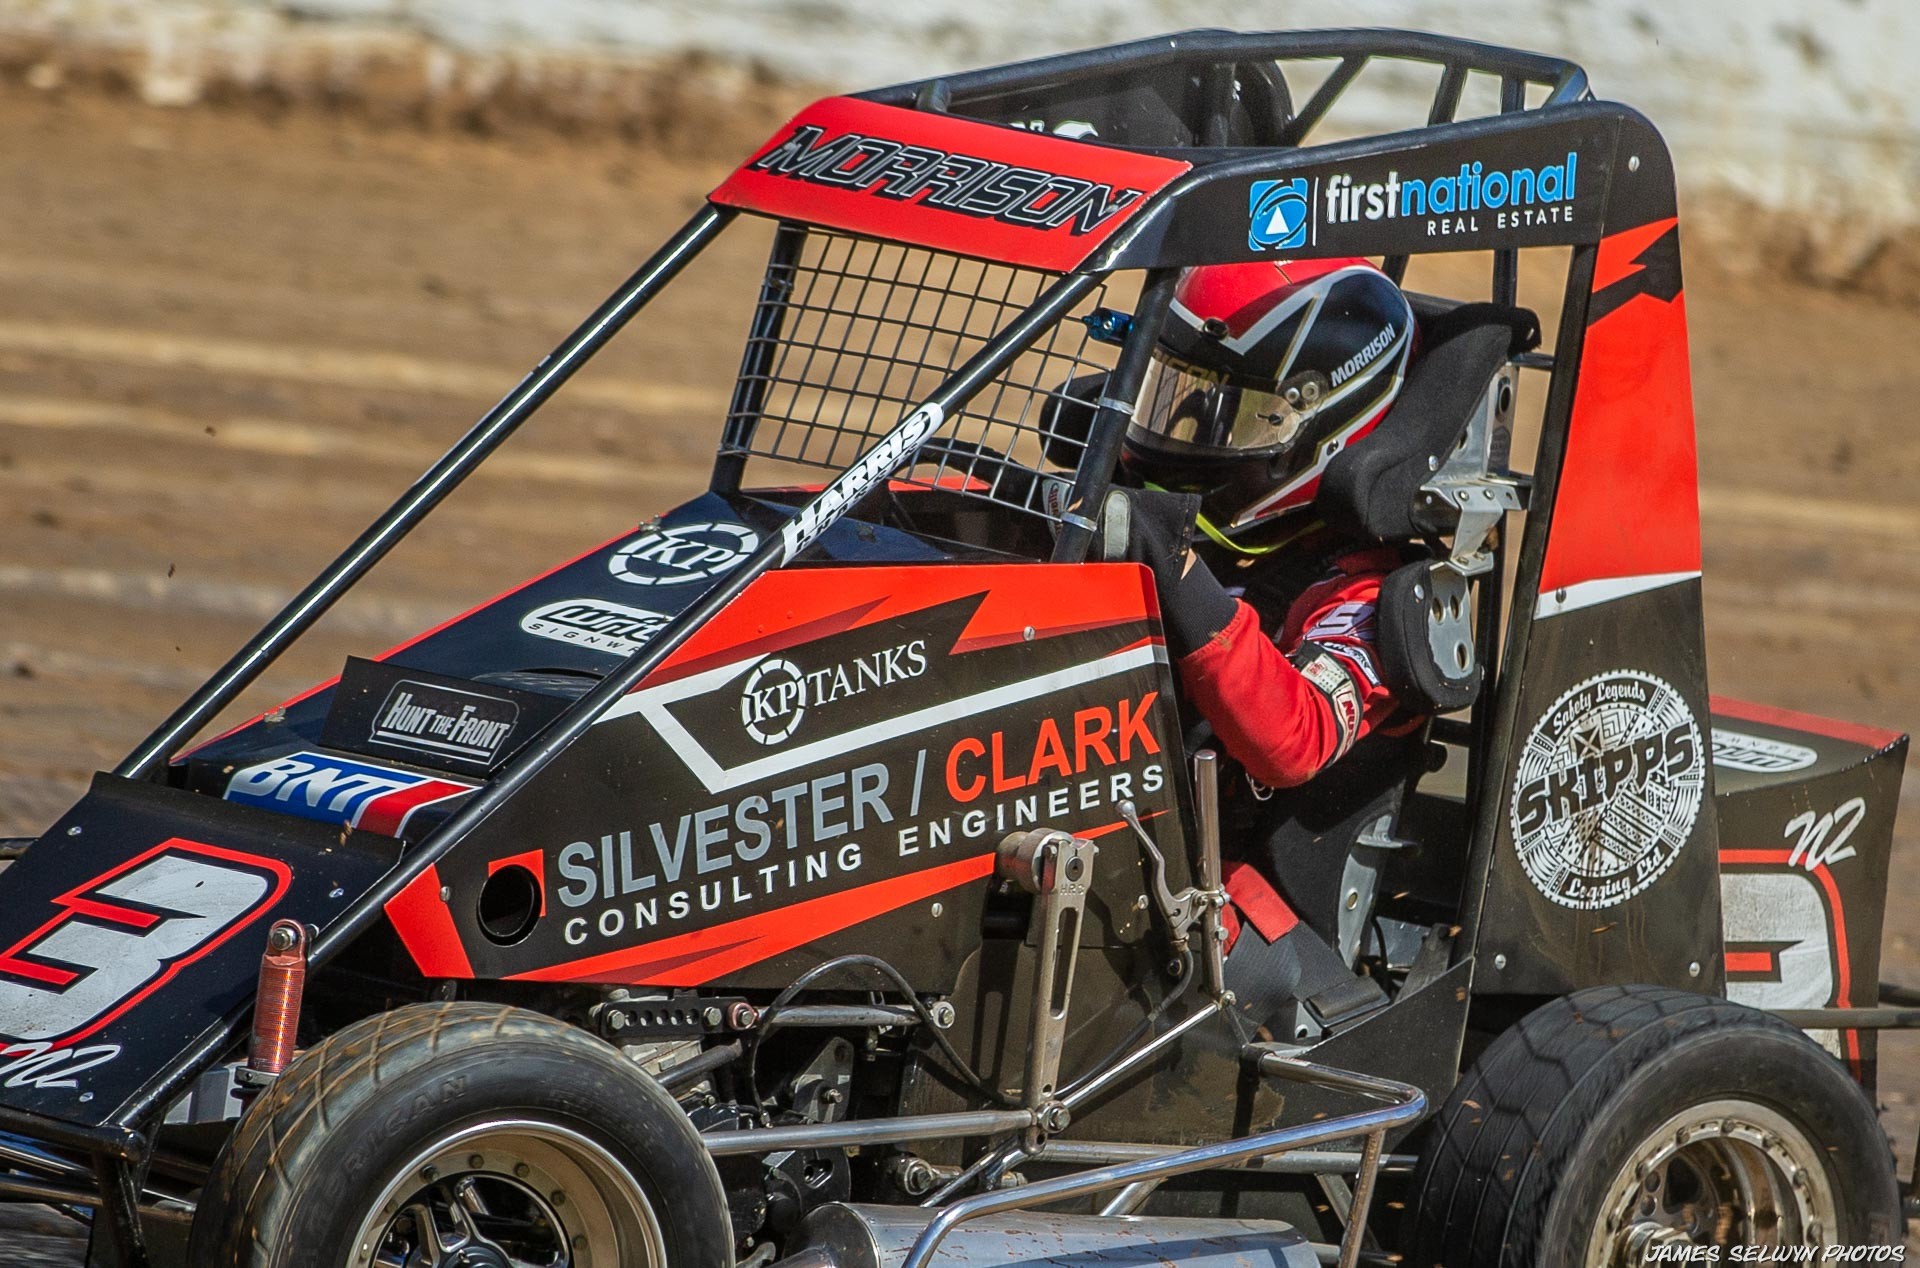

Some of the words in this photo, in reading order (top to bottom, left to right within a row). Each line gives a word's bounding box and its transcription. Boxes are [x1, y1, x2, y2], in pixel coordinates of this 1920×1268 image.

[749, 126, 1144, 236] MORRISON
[1427, 216, 1479, 236] REAL
[1497, 206, 1573, 229] ESTATE
[1331, 322, 1396, 388] MORRISON
[783, 411, 931, 562] HARRIS
[631, 536, 736, 570] KP
[751, 681, 798, 724] KP
[807, 640, 927, 706] TANKS
[1596, 682, 1647, 702] Legends
[381, 692, 436, 735] HUNT
[429, 714, 456, 735] THE
[447, 705, 511, 749] FRONT
[234, 757, 400, 813] BNT
[557, 762, 895, 909] SILVESTER
[946, 691, 1162, 804] CLARK
[1516, 722, 1694, 838] SKIPPS
[564, 843, 862, 945] CONSULTING
[898, 764, 1165, 858] ENGINEERS
[1566, 875, 1631, 901] Logging
[1636, 848, 1666, 882] Ltd
[0, 850, 274, 1042] 3
